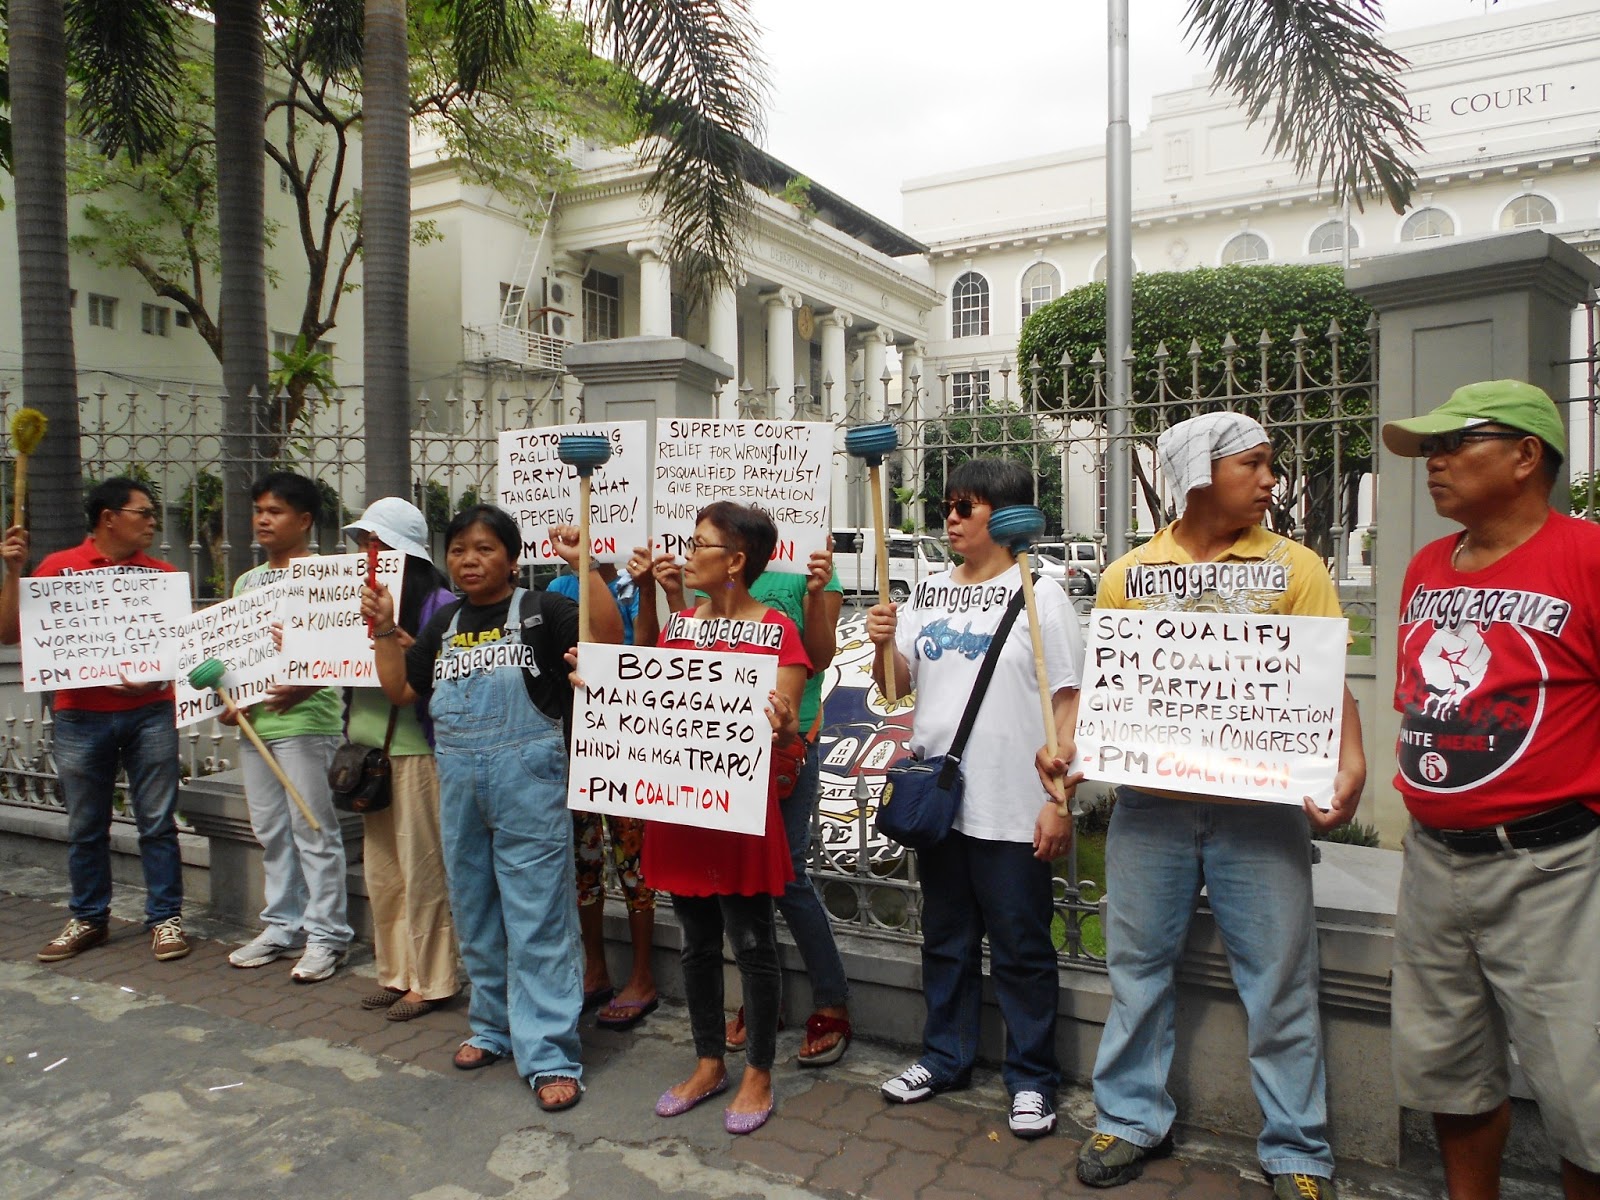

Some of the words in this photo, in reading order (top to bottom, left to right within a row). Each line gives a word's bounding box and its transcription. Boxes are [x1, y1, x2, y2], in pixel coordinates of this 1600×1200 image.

[1450, 82, 1553, 116] COURT
[516, 428, 621, 449] TOTOG
[670, 421, 746, 439] SUPREME
[754, 423, 811, 442] COURT:
[510, 447, 560, 466] PAGLIL
[659, 441, 703, 460] RELIEF
[709, 445, 733, 461] FOR
[513, 465, 606, 486] PARTYLT,
[656, 463, 736, 482] DISQUALIFIED
[501, 485, 571, 505] TANGGALIN
[580, 477, 629, 496] AHAT
[667, 481, 691, 495] GIVE
[520, 507, 574, 528] PEKENG
[589, 496, 638, 525] RUPO!
[667, 502, 705, 520] WORK
[520, 541, 537, 559] M
[292, 562, 340, 581] BIGYAN
[343, 566, 353, 577] NG
[356, 558, 400, 577] BSES
[1125, 563, 1287, 599] Manggagawa
[30, 580, 105, 599] SUPREME
[287, 585, 304, 598] ANG
[912, 581, 1014, 614] Manggaga
[50, 597, 110, 614] RELIEF
[122, 596, 152, 608] FOR
[40, 612, 165, 631] LEGITIMATE
[177, 613, 218, 638] QUALIFY
[221, 606, 237, 622] PM
[291, 616, 304, 629] SA
[308, 610, 368, 632] KONGGRE
[34, 631, 116, 649] WORKING
[124, 626, 176, 641] CLASS
[180, 638, 195, 652] AS
[1096, 615, 1143, 640] SC:
[1155, 618, 1291, 652] QUALIFY
[53, 641, 160, 661] PARTYLIST!
[178, 653, 197, 670] GIVE
[203, 626, 272, 658] REPRESENTA
[248, 642, 280, 667] CONGR
[79, 659, 161, 680] COALITION
[312, 660, 373, 679] COALITION
[435, 645, 534, 682] anggagawa
[617, 653, 723, 683] BOSES
[734, 666, 758, 688] NG
[1095, 647, 1140, 670] PM
[1152, 649, 1302, 675] COALITION
[1095, 673, 1125, 693] AS
[1138, 673, 1292, 702] PARTYLIST!
[586, 685, 754, 716] MANGGAGAWA
[1088, 692, 1134, 713] GIVE
[1148, 697, 1334, 724] REPRESENTATION
[585, 710, 608, 730] SA
[619, 712, 755, 743] KONGGRESO
[1077, 719, 1095, 738] to
[1100, 720, 1192, 746] WORKERS
[1219, 723, 1334, 759] CONGRESS!
[1438, 734, 1495, 752] HERE!
[575, 737, 620, 761] HINDI
[628, 746, 647, 762] NG
[651, 747, 682, 767] MGA
[684, 746, 763, 782] TRAPO!
[1155, 751, 1290, 790] COALITION
[1425, 754, 1445, 781] 5
[634, 778, 730, 813] COALITION
